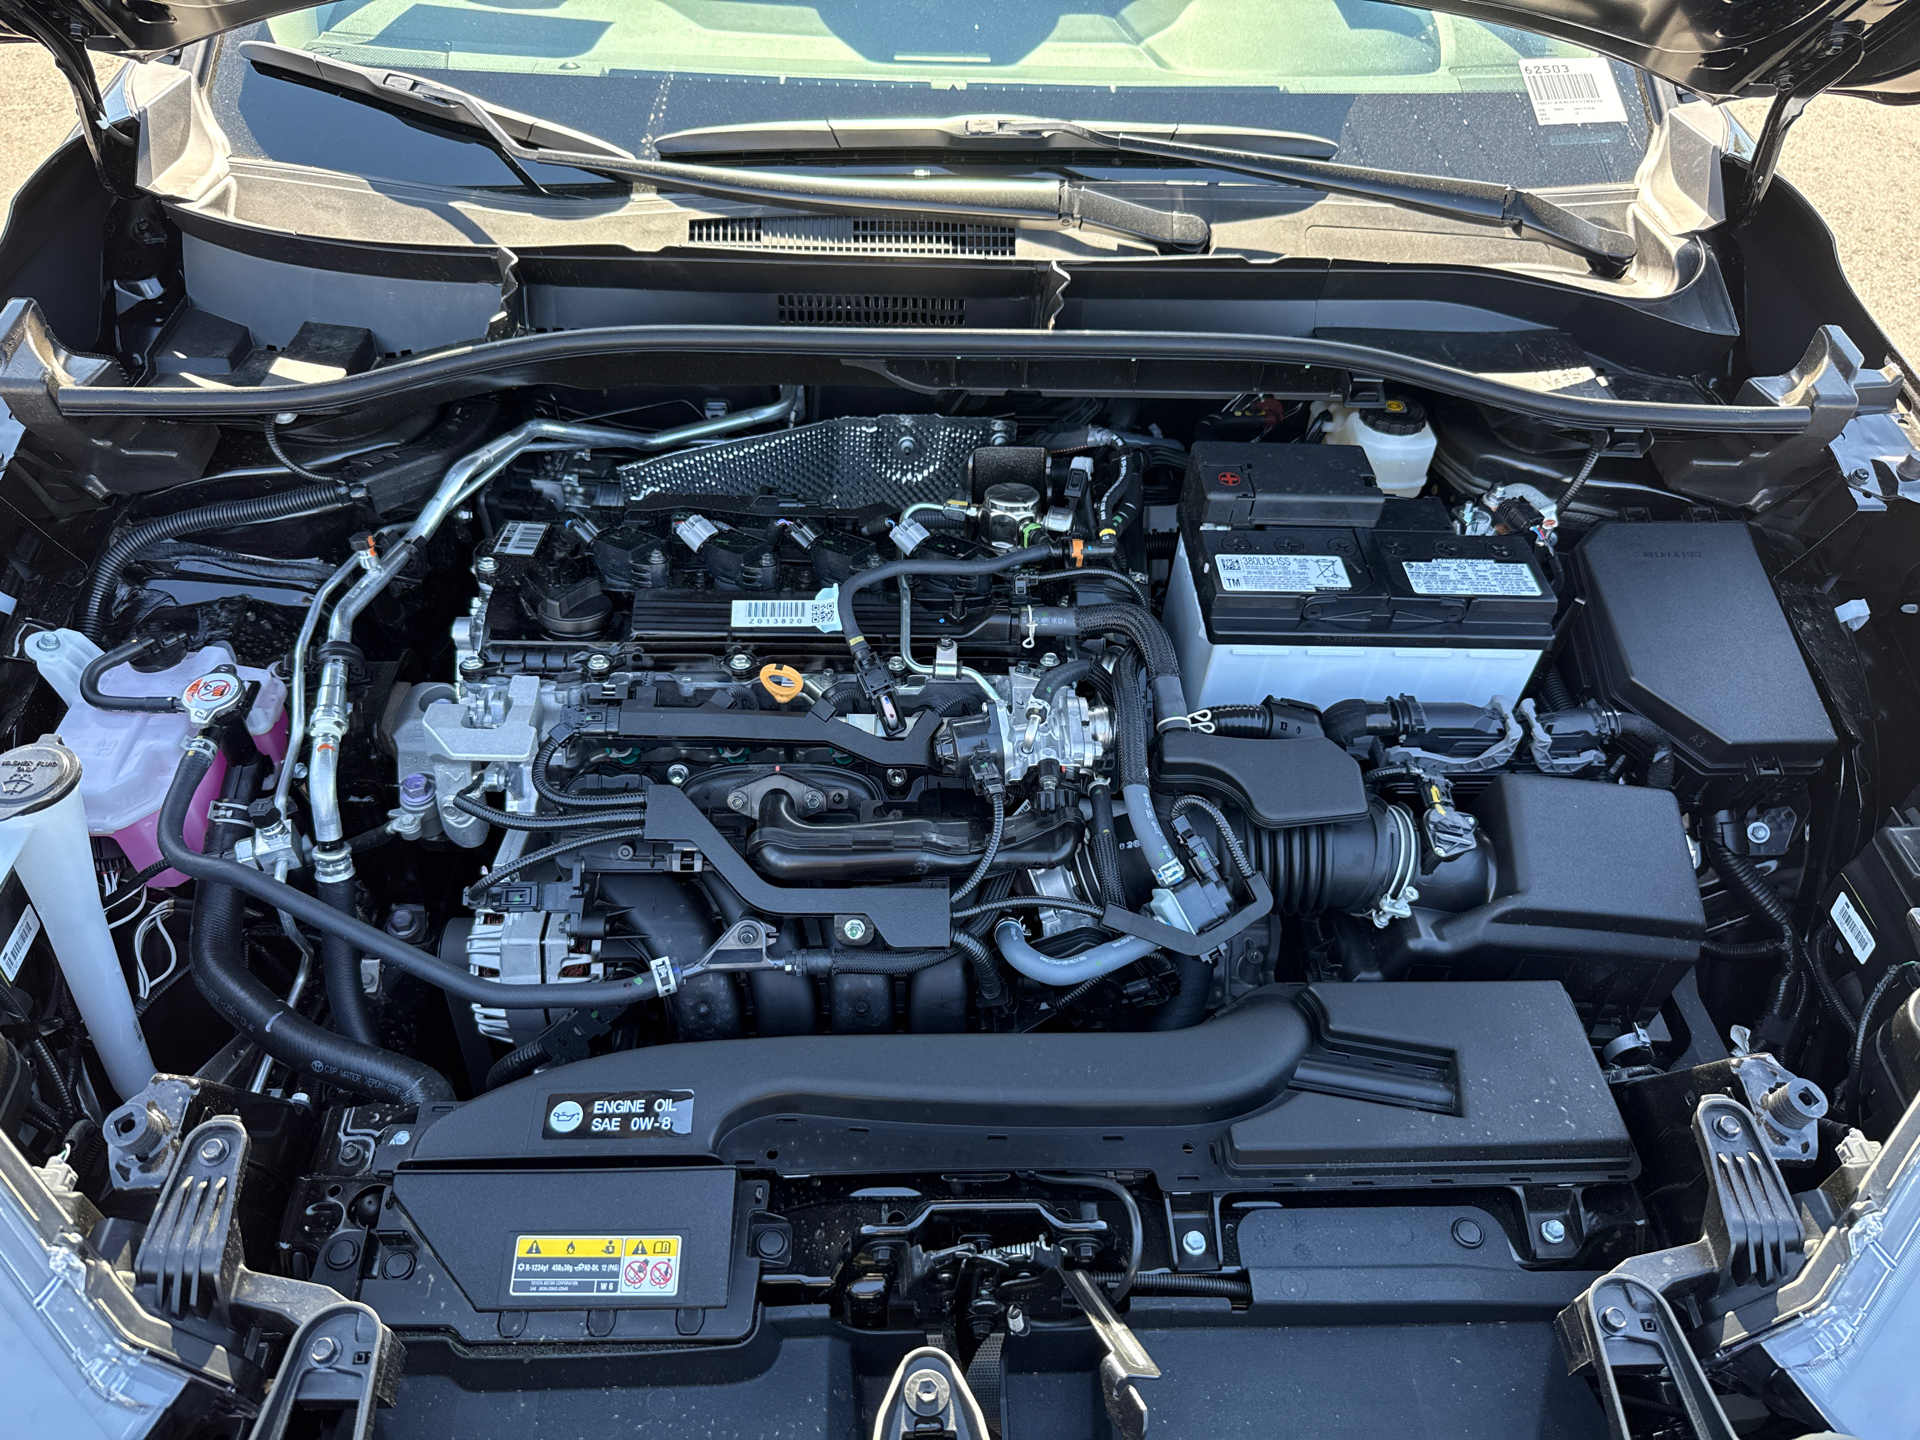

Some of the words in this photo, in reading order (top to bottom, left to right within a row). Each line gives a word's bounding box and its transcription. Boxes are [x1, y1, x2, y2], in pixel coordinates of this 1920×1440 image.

[1524, 64, 1570, 75] 62503
[1242, 556, 1291, 566] 380LN3-ISS
[1226, 578, 1241, 588] TM
[340, 1069, 362, 1083] WATER
[593, 1099, 646, 1114] ENGINE
[653, 1098, 677, 1112] OIL
[591, 1117, 622, 1131] SAE
[630, 1116, 671, 1130] 0W-8
[525, 1263, 549, 1273] R-1234yf
[600, 1282, 608, 1291] W
[608, 1282, 614, 1291] 6
